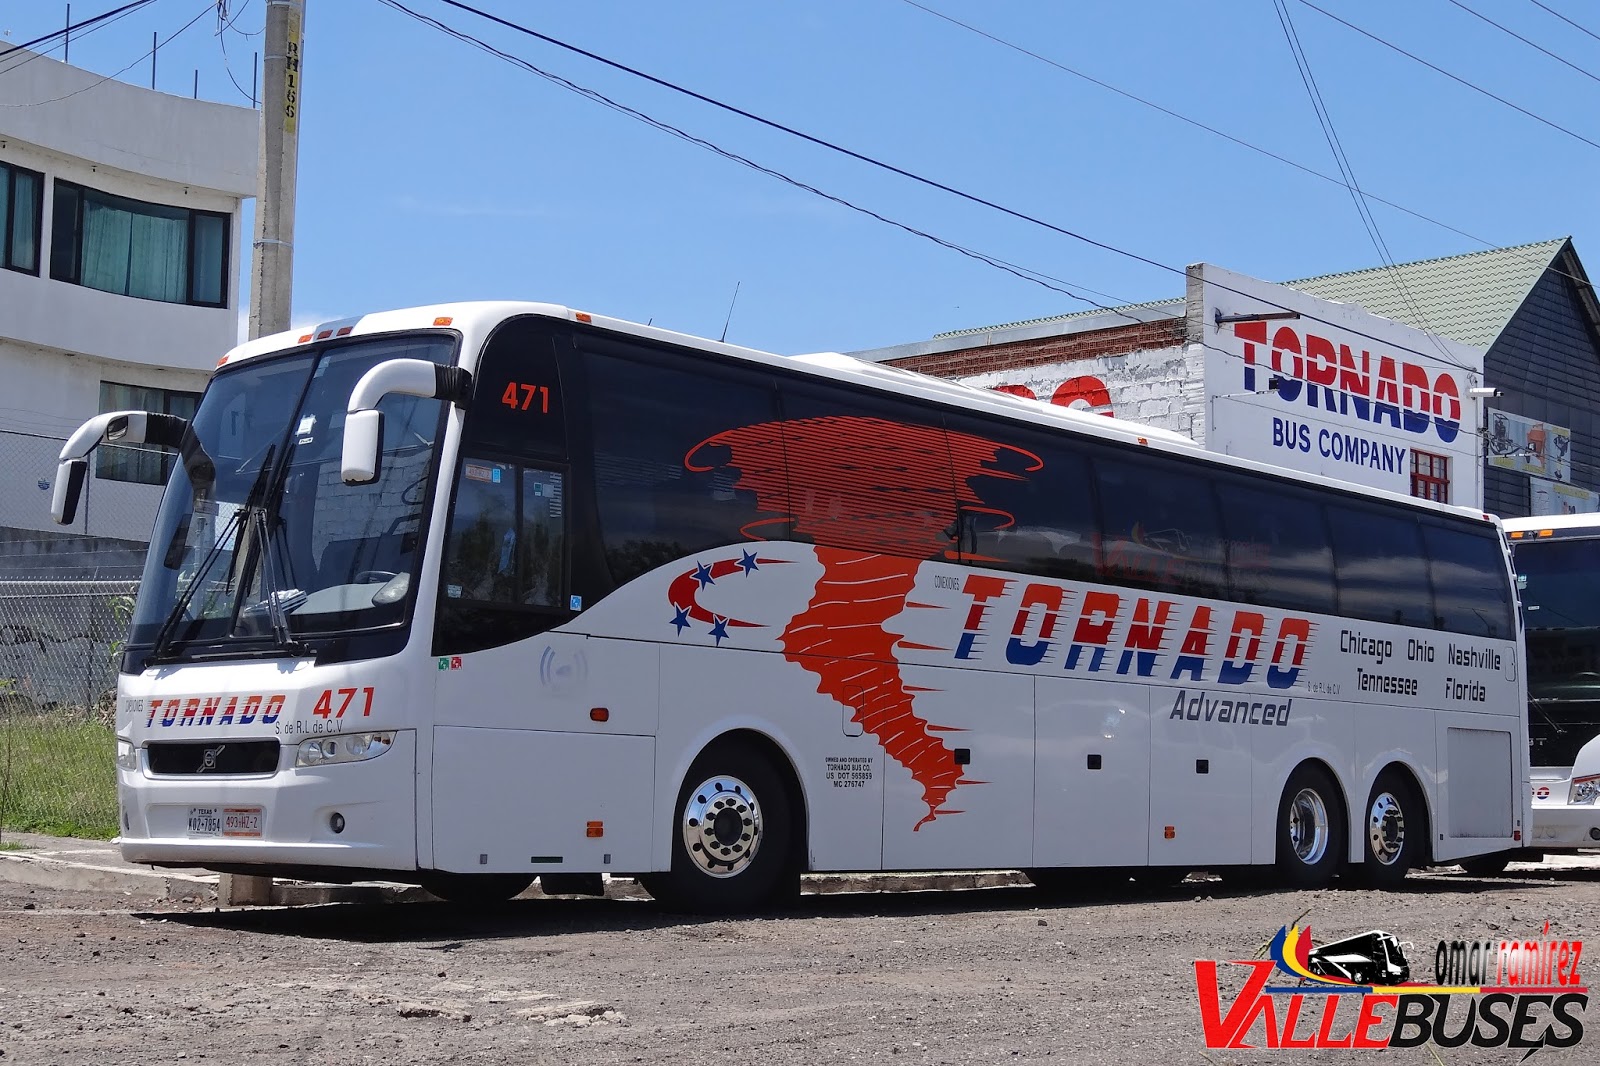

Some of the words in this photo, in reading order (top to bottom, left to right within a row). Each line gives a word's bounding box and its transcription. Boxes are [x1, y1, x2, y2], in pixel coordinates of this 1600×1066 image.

[501, 382, 549, 414] 471
[1234, 321, 1462, 443] TORNADO
[1273, 417, 1311, 454] BUS
[1318, 428, 1406, 475] COMPANY
[934, 575, 960, 591] CONEXIONES
[954, 573, 1321, 690] TORNADO
[1340, 629, 1393, 665] Chicago
[1407, 638, 1435, 663] Ohio
[1448, 642, 1501, 671] Nashville
[1356, 667, 1418, 696] Tennessee
[1445, 677, 1486, 702] Florida
[144, 694, 287, 728] TORNADO
[312, 686, 375, 719] 471
[1169, 690, 1293, 727] Advanced
[284, 721, 294, 734] de
[312, 720, 323, 733] de
